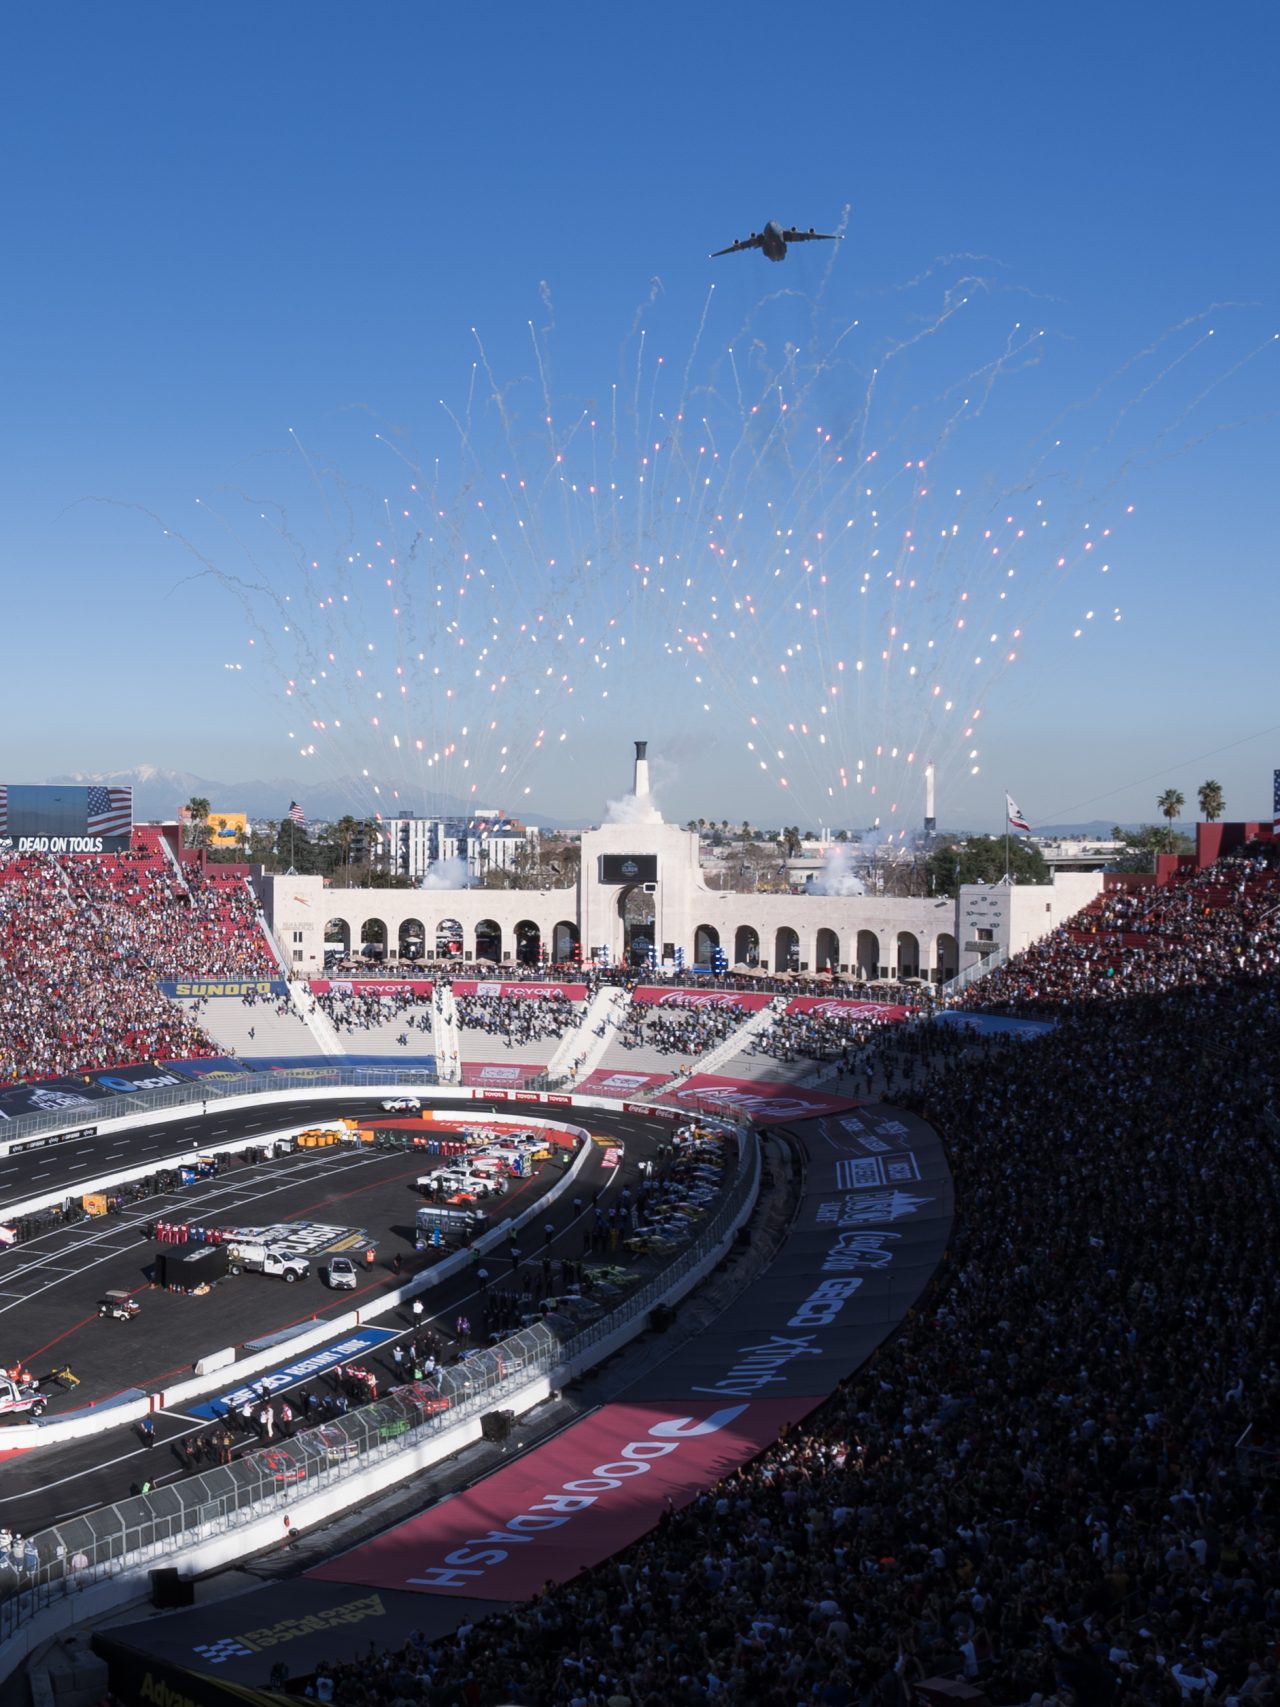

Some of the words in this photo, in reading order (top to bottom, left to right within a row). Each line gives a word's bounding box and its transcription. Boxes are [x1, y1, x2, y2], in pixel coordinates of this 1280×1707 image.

[19, 837, 50, 852] DEAD
[50, 837, 68, 852] ON
[67, 837, 103, 852] TOOLS
[176, 983, 270, 995] SUNOCO
[358, 985, 412, 995] TOYOTA
[506, 987, 563, 996] TOYOTA
[132, 1075, 181, 1089] SCW
[484, 1091, 505, 1099] TOYOTA
[549, 1095, 569, 1103] TOYOTA
[271, 1223, 349, 1253] CLASH
[786, 1277, 864, 1327] GEICO
[284, 1352, 343, 1376] RESTART
[332, 1339, 372, 1354] ZONE
[691, 1334, 822, 1395] xfinity
[406, 1441, 680, 1588] DOORDASH
